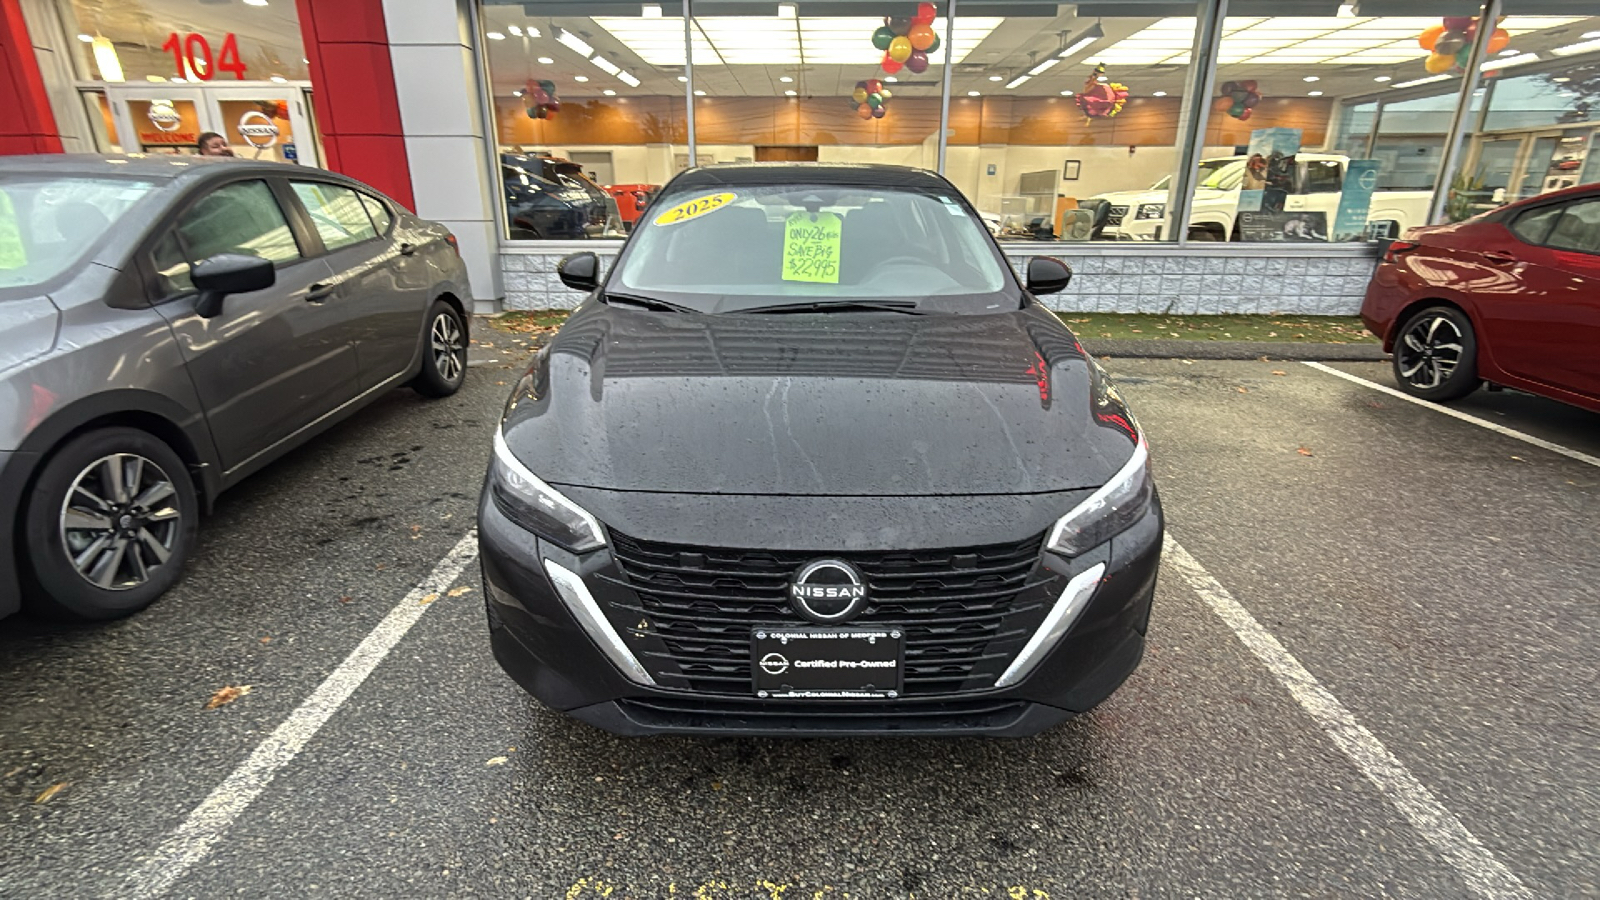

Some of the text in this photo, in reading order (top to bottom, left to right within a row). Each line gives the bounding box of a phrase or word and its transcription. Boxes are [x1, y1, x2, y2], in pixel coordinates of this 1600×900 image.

[162, 32, 247, 81] 104
[141, 132, 196, 143] WELCOME
[673, 194, 724, 220] 2025
[789, 228, 813, 245] ONLY
[811, 226, 825, 240] 26
[787, 242, 813, 257] SAVE
[792, 585, 865, 597] NISSAN
[794, 660, 896, 668] Certified Pre-Owned
